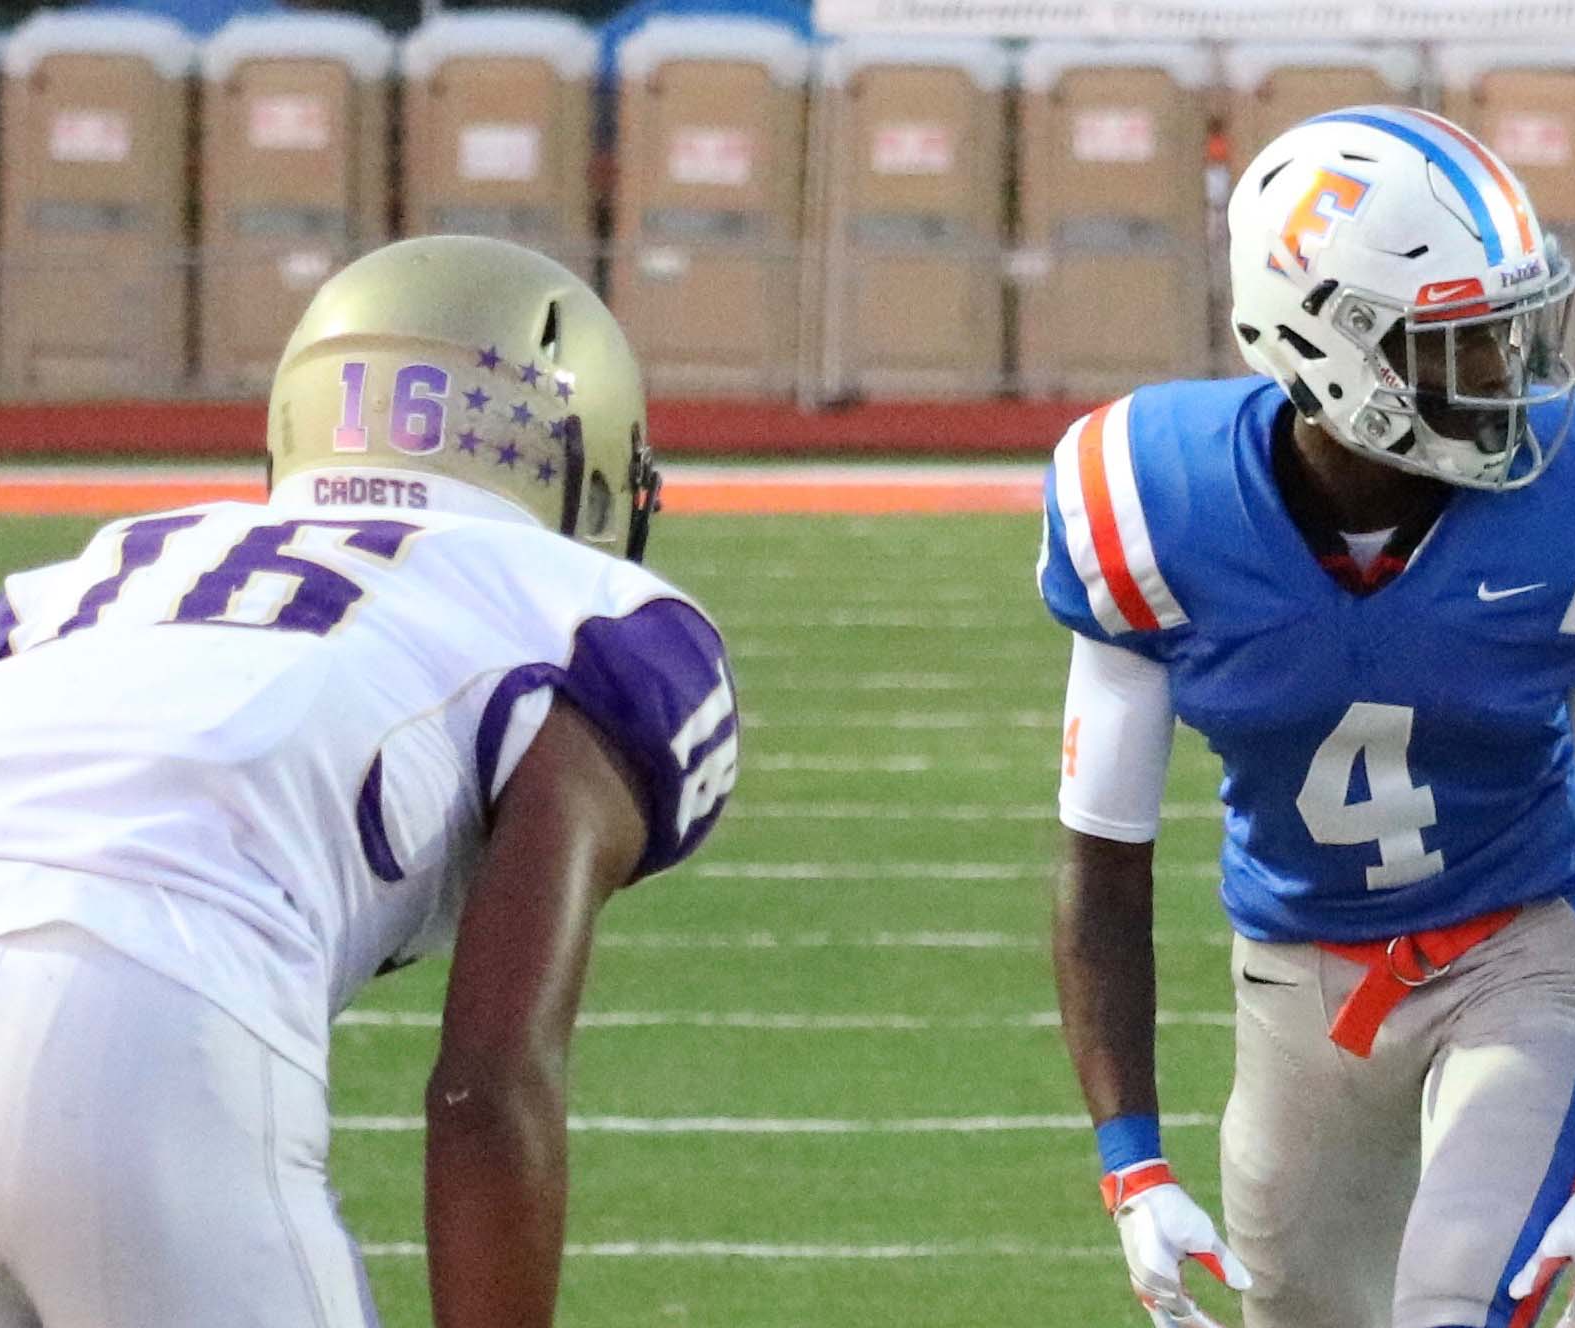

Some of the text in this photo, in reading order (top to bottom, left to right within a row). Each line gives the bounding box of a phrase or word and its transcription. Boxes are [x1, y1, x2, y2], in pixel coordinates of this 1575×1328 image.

[333, 361, 450, 456] 16
[313, 476, 428, 510] CADETS
[28, 512, 427, 652] 16
[1064, 716, 1081, 777] 4
[1296, 701, 1444, 890] 4
